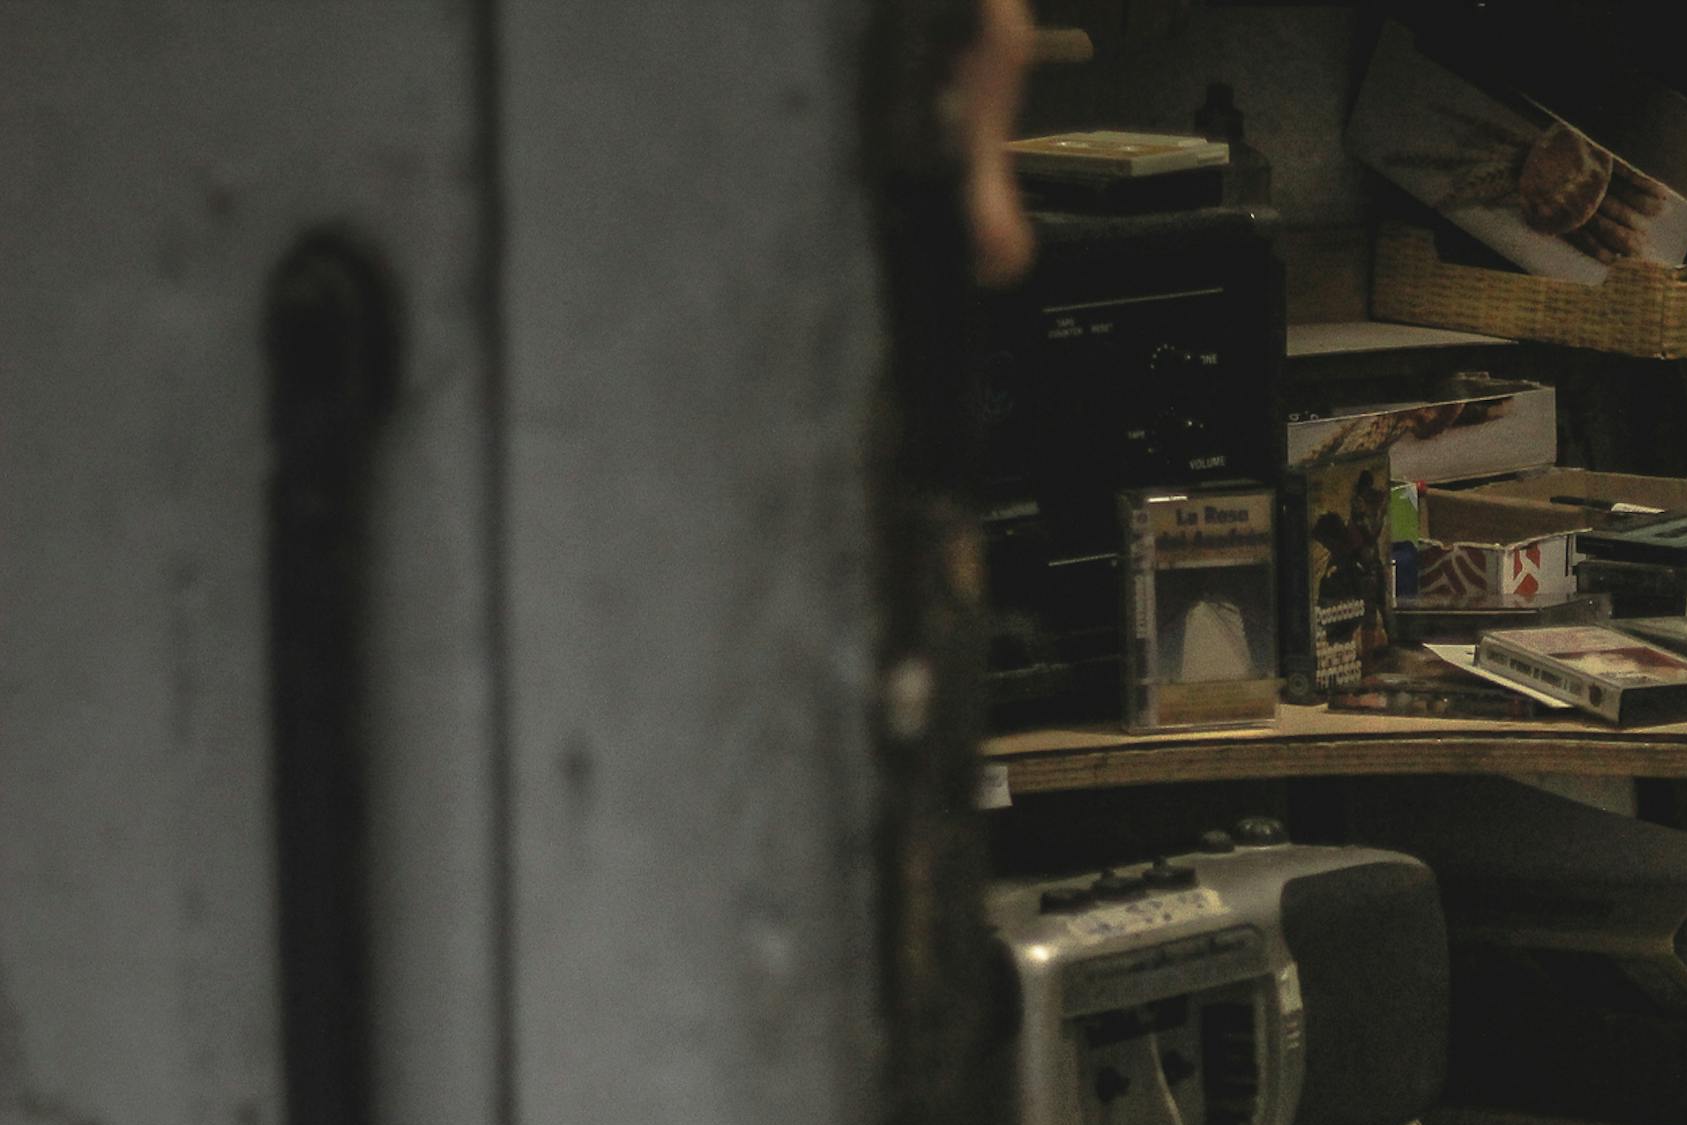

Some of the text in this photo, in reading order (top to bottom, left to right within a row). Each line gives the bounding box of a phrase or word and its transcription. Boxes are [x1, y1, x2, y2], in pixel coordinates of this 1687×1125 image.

[1188, 455, 1226, 470] VOLUME
[1176, 506, 1249, 526] La Rosa
